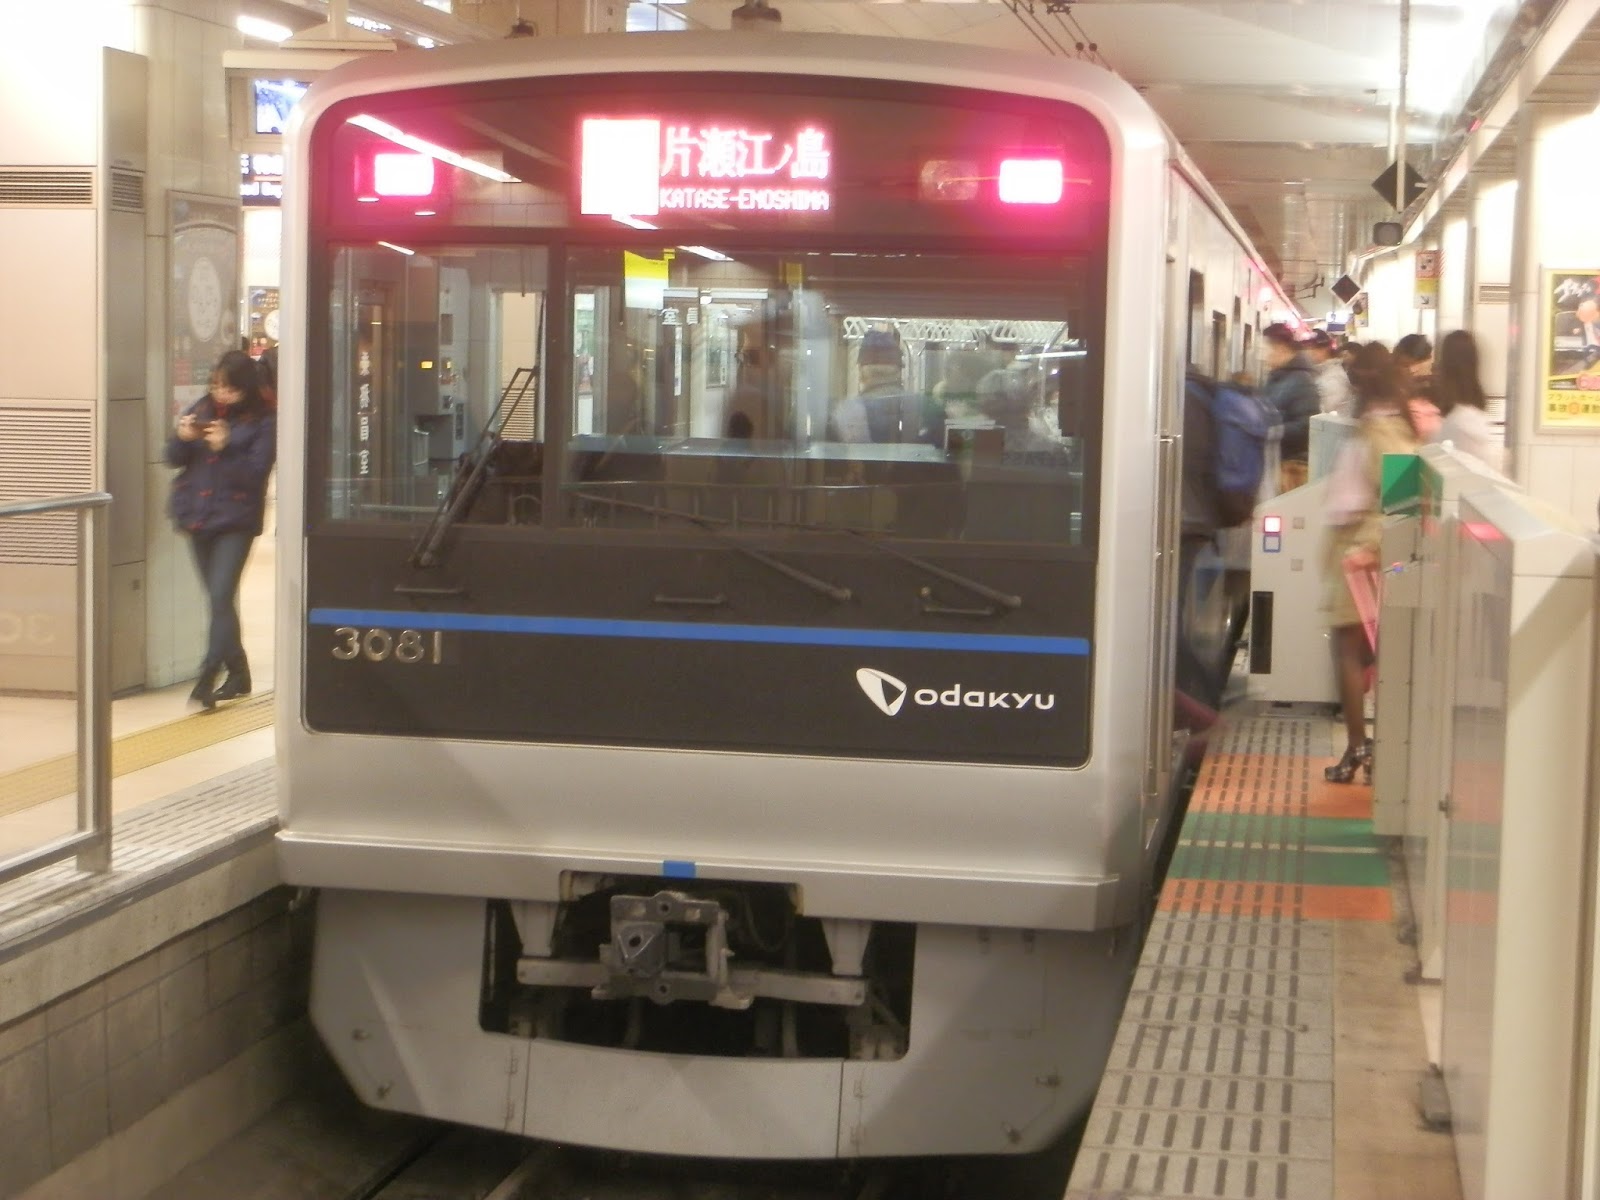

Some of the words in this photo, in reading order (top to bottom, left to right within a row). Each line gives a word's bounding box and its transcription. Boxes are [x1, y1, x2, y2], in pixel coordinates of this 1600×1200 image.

[660, 126, 830, 179] 片瀬江ノ島
[332, 626, 443, 665] 3081
[914, 683, 1055, 710] odakyu
